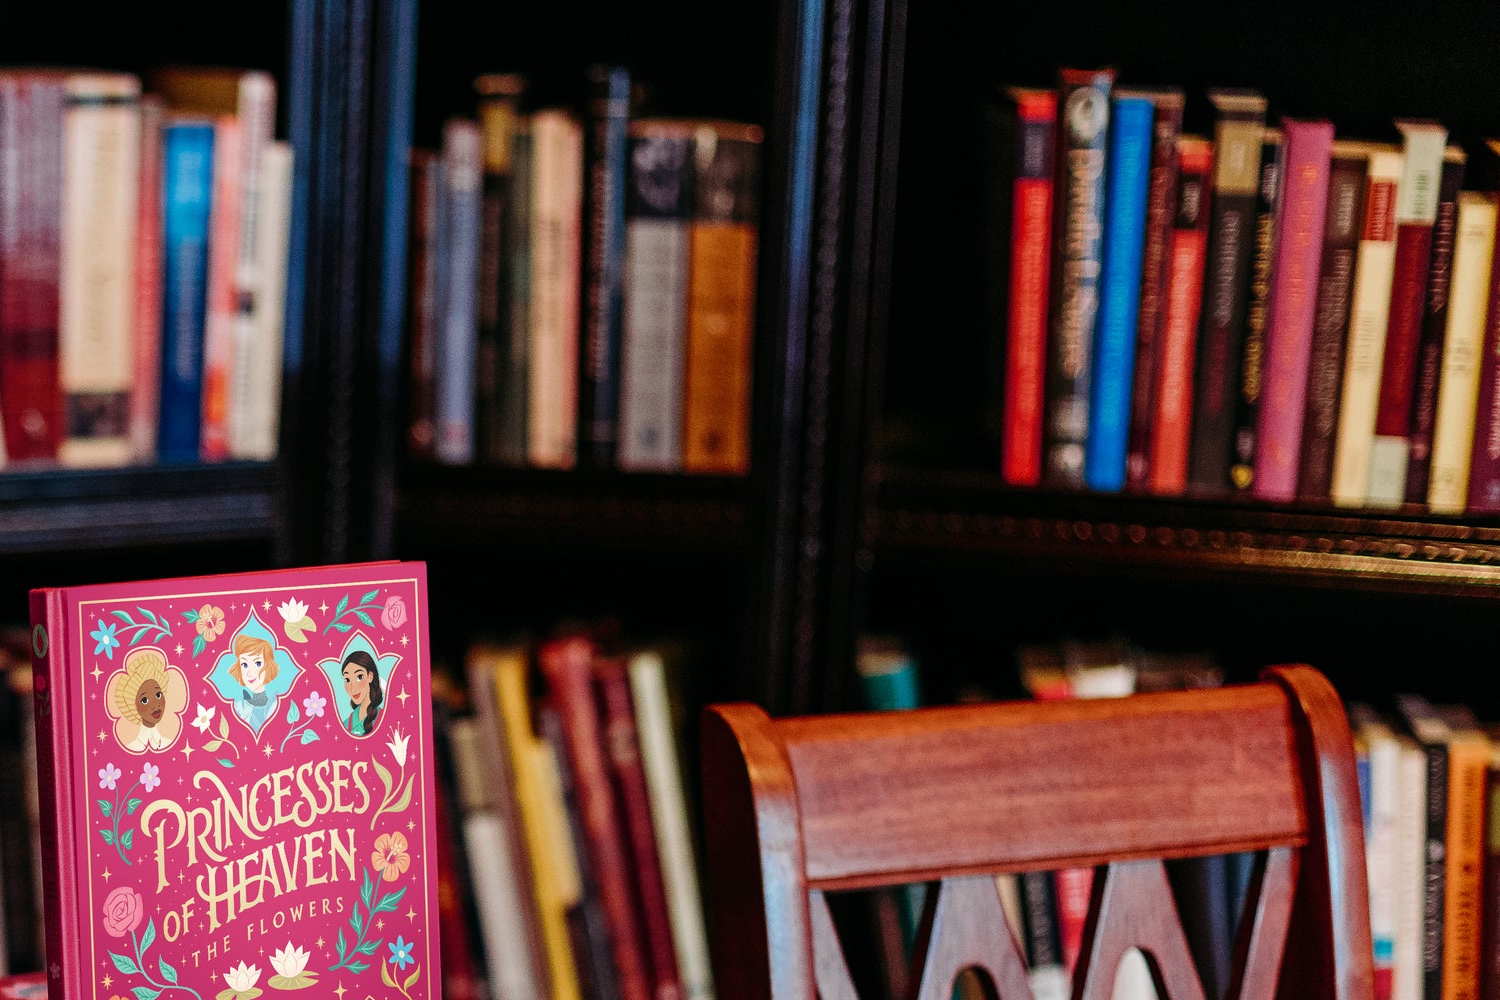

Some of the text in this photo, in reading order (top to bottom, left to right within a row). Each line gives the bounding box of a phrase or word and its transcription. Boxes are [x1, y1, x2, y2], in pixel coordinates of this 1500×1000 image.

[140, 757, 373, 895] PRINCESSES
[163, 828, 358, 944] OF HEAVEN
[190, 896, 347, 969] THE FLOWERS
